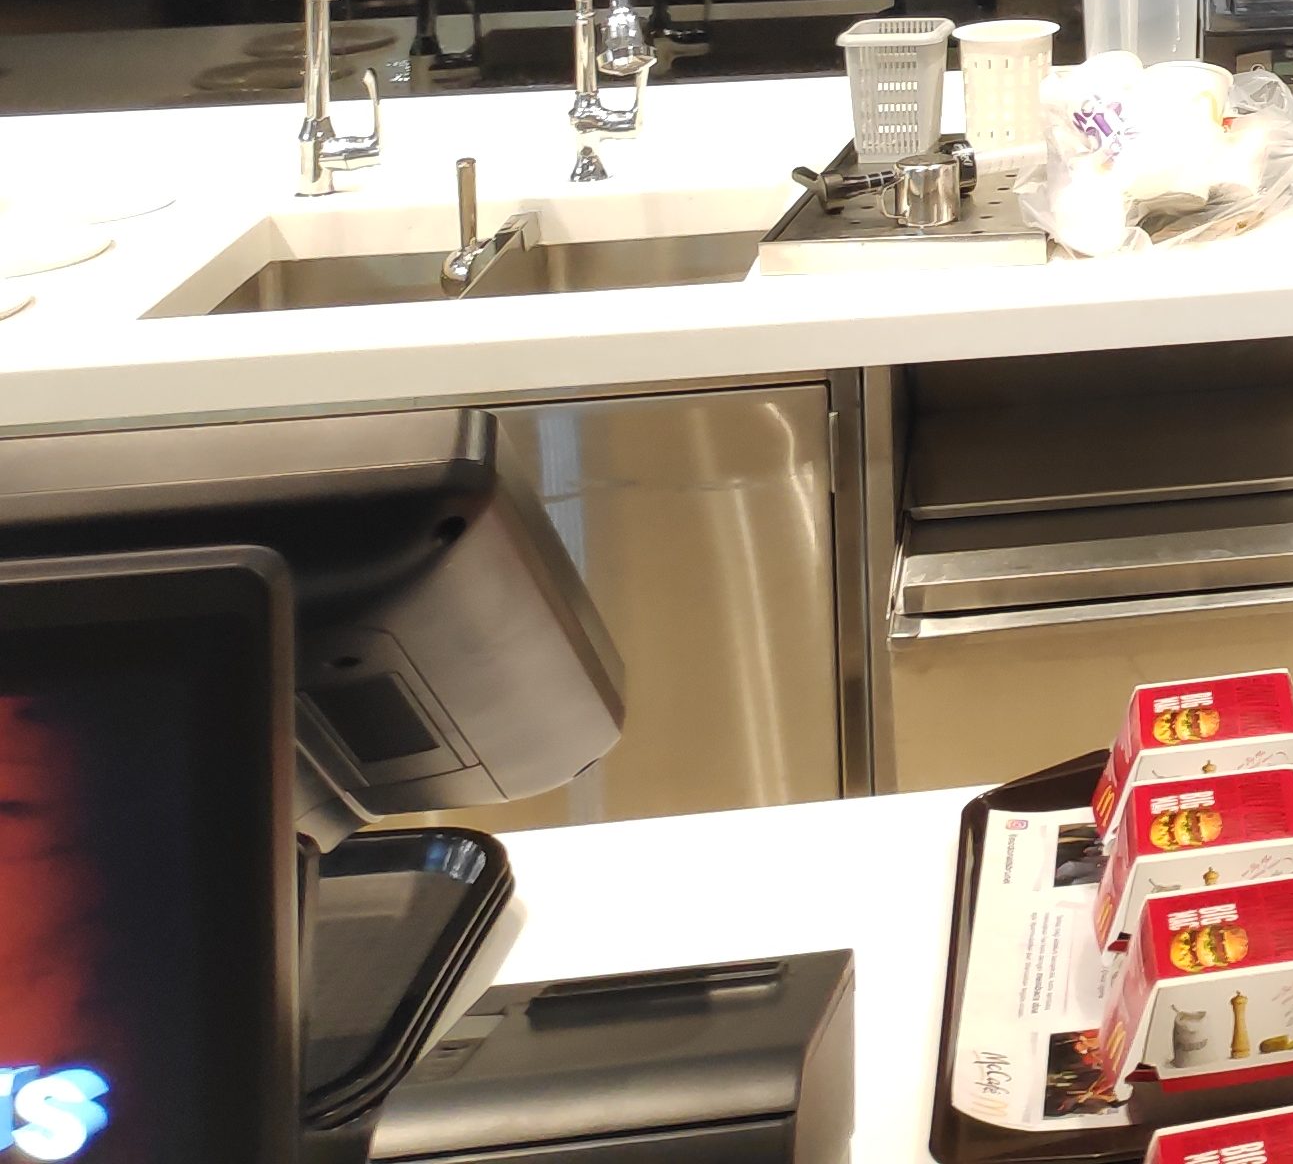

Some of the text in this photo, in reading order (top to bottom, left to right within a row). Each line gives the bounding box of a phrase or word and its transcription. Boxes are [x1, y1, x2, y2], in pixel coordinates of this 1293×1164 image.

[1153, 696, 1180, 713] MAC
[1179, 691, 1214, 708] BIG
[1150, 795, 1180, 814] MAC
[1179, 790, 1215, 810] BIG
[1167, 909, 1200, 932] MAC
[1199, 903, 1239, 925] BIG
